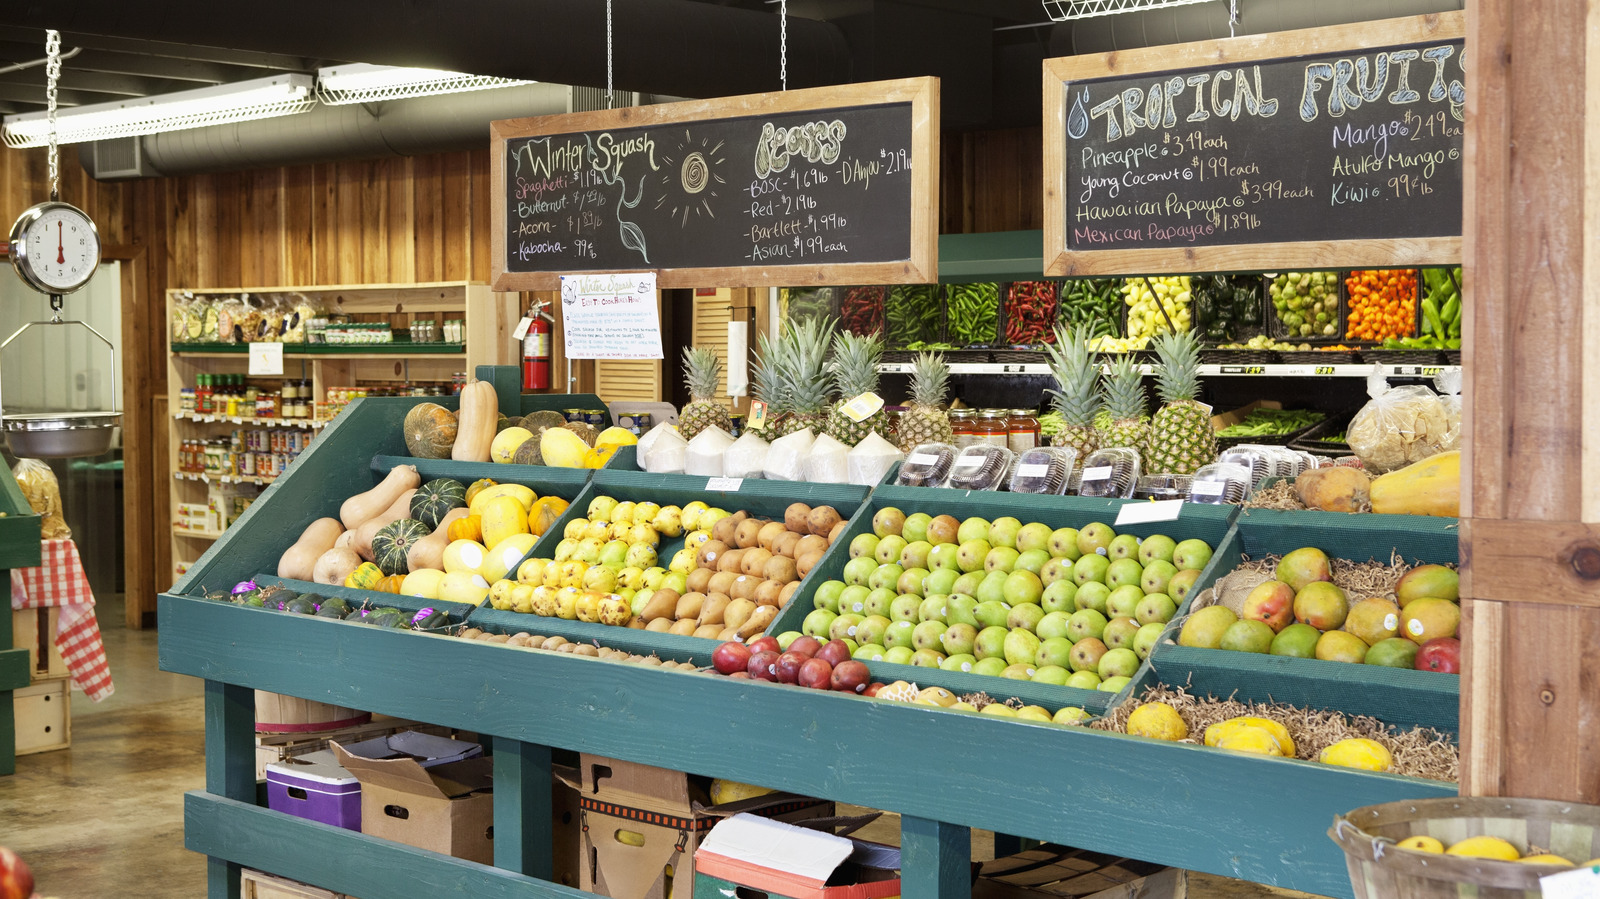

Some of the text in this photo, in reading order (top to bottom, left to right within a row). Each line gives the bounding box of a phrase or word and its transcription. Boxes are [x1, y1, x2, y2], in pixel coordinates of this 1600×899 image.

[1090, 65, 1279, 143] TROPICAL
[1081, 142, 1158, 169] Pineapple
[1332, 120, 1400, 162] Mango
[527, 132, 660, 180] Winter Squash
[1388, 150, 1444, 179] Mango
[1122, 168, 1180, 187] Coconut
[1076, 200, 1161, 222] Hawaiian
[1165, 192, 1231, 222] Papaya
[1331, 182, 1368, 206] Kiwi
[1074, 225, 1142, 244] Mexican
[1147, 223, 1204, 242] Papaya
